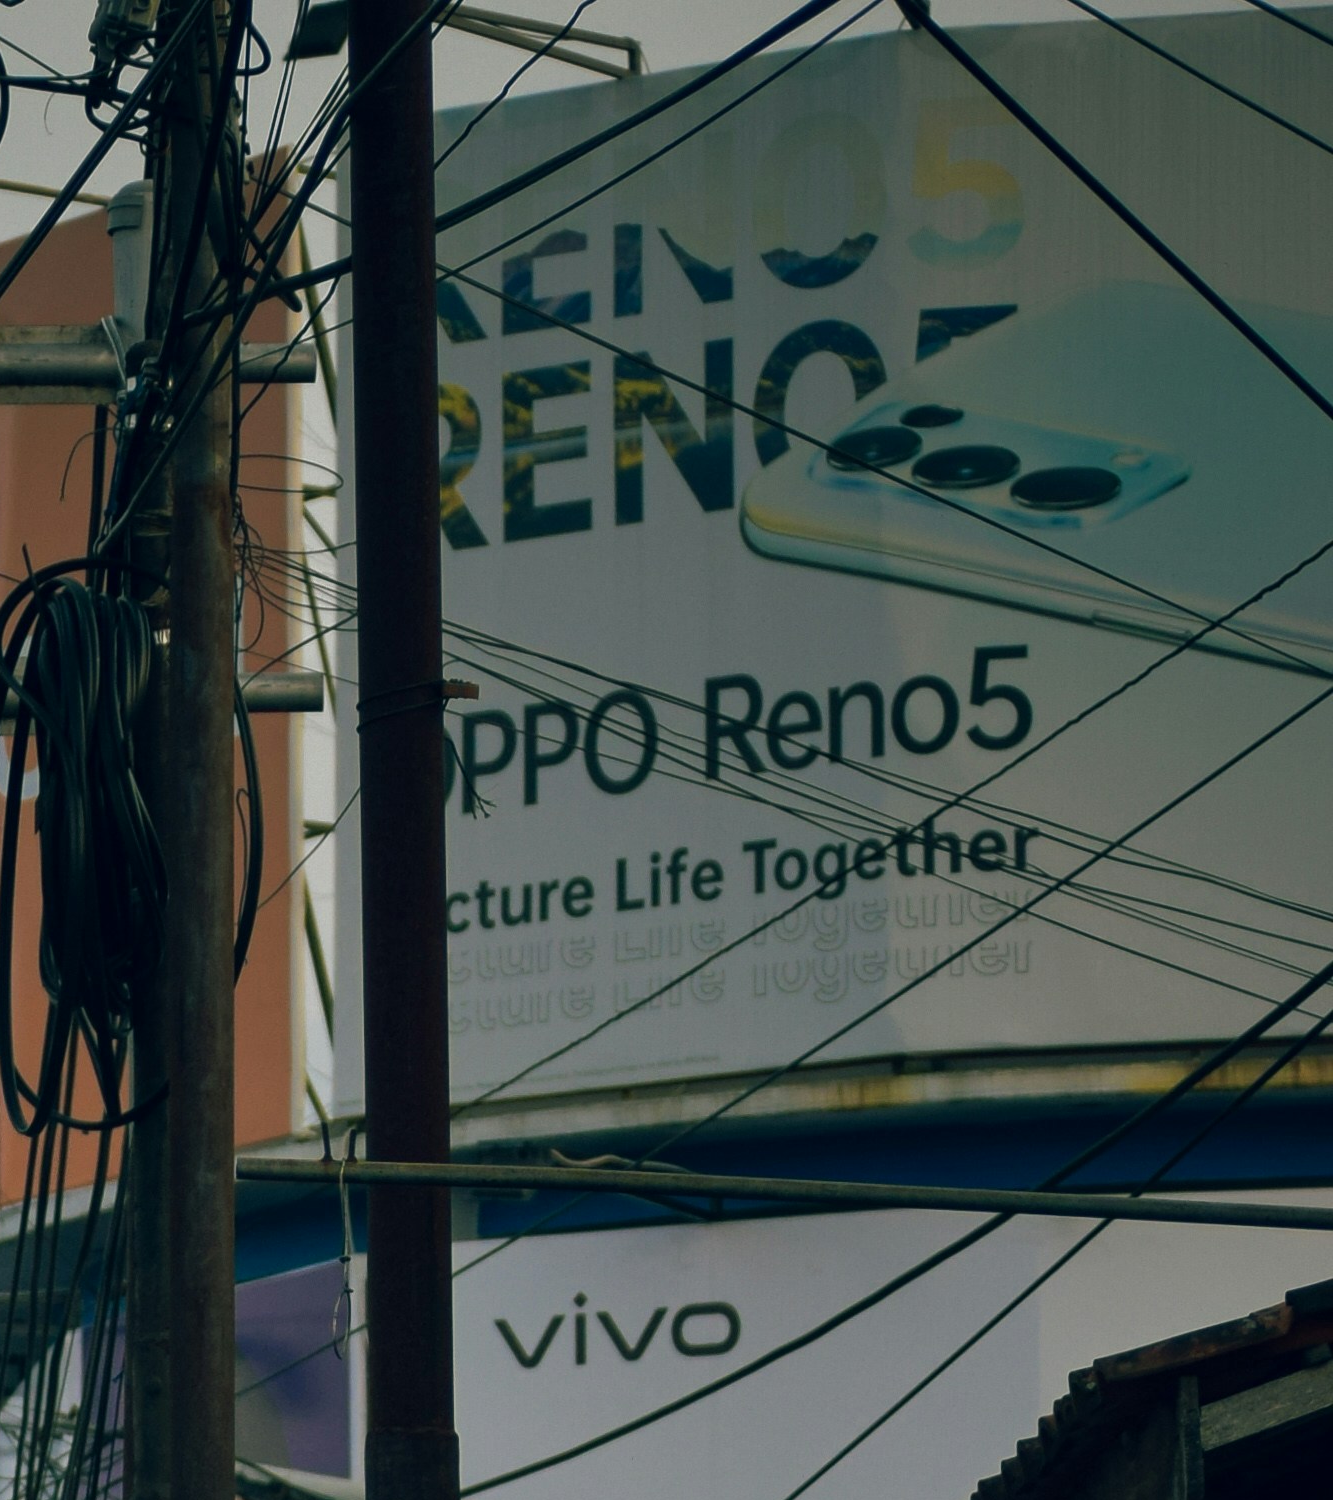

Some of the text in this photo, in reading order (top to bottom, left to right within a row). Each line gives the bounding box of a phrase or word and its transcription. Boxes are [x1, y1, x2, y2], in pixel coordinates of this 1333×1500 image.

[704, 644, 1033, 782] Reno5
[446, 816, 1041, 934] cture Life Together
[495, 1292, 741, 1368] vivo
